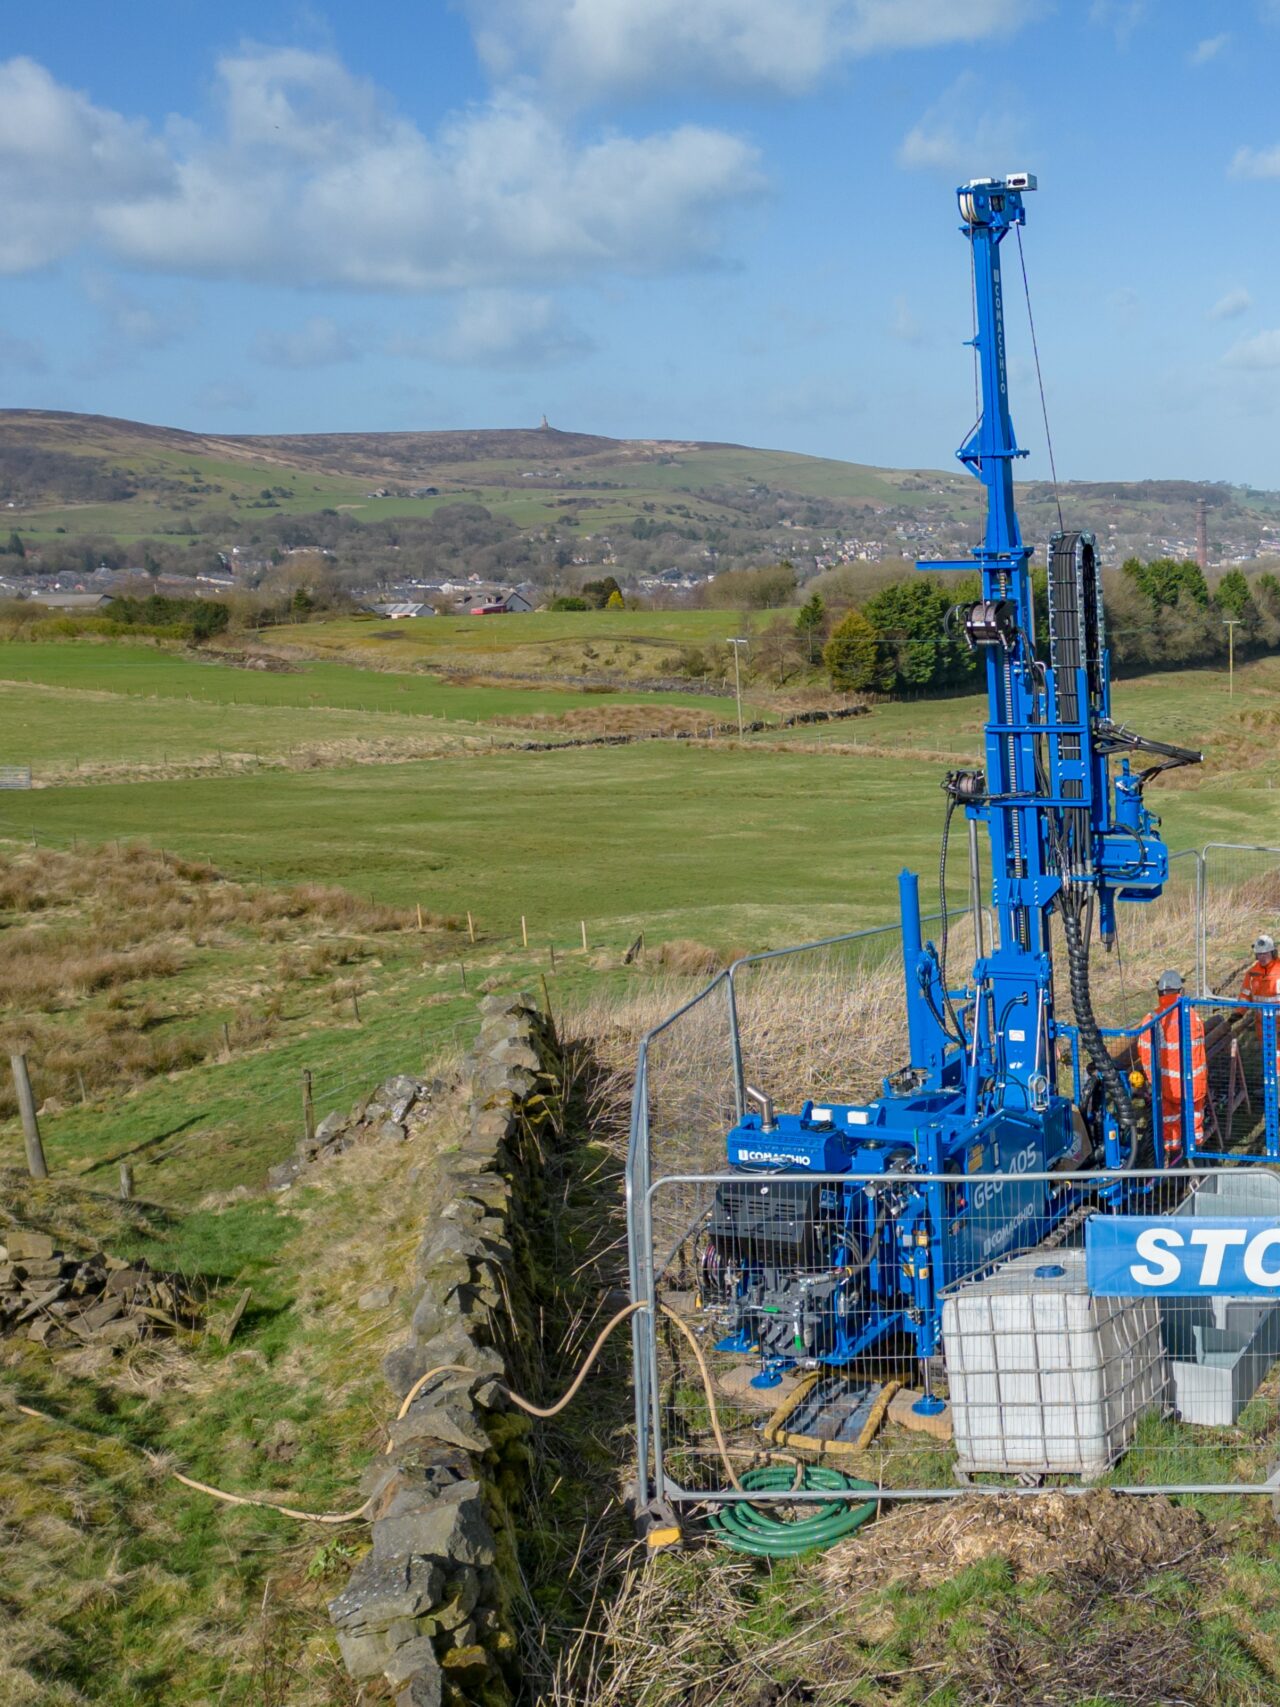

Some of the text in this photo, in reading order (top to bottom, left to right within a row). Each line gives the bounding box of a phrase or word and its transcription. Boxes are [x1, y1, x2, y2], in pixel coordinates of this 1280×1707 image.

[994, 285, 1006, 395] COMACCHIO
[974, 1169, 1003, 1210] GEO
[1008, 1142, 1036, 1175] 405
